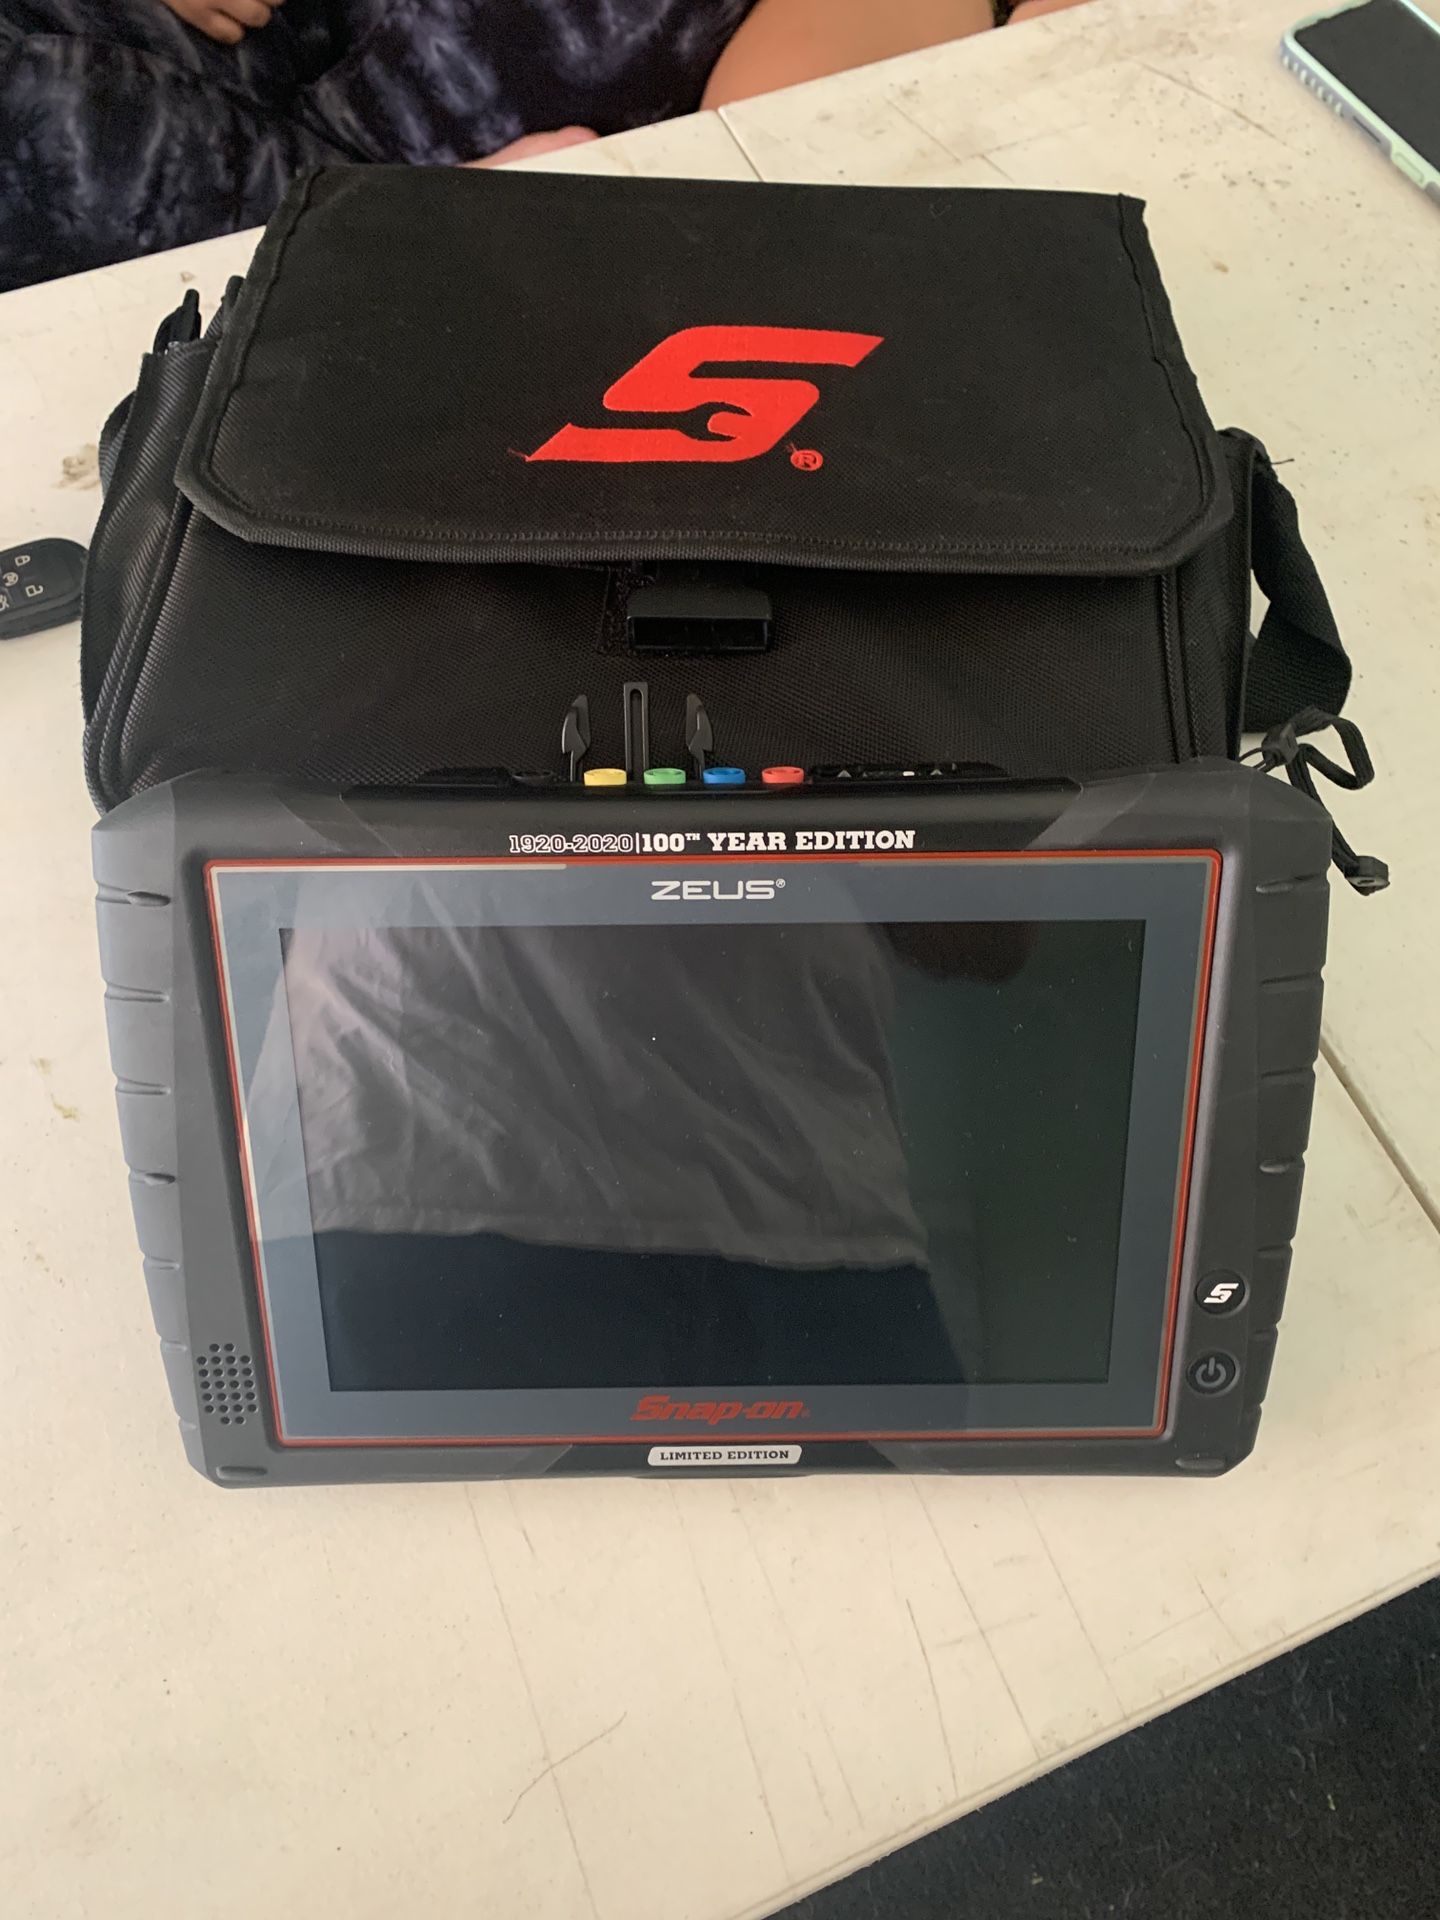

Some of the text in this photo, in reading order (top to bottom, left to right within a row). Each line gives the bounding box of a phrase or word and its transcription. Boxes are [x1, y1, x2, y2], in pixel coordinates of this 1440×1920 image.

[706, 832, 787, 851] YEAR
[795, 830, 915, 850] EDITION
[660, 1450, 789, 1461] LIMITED EDITION
